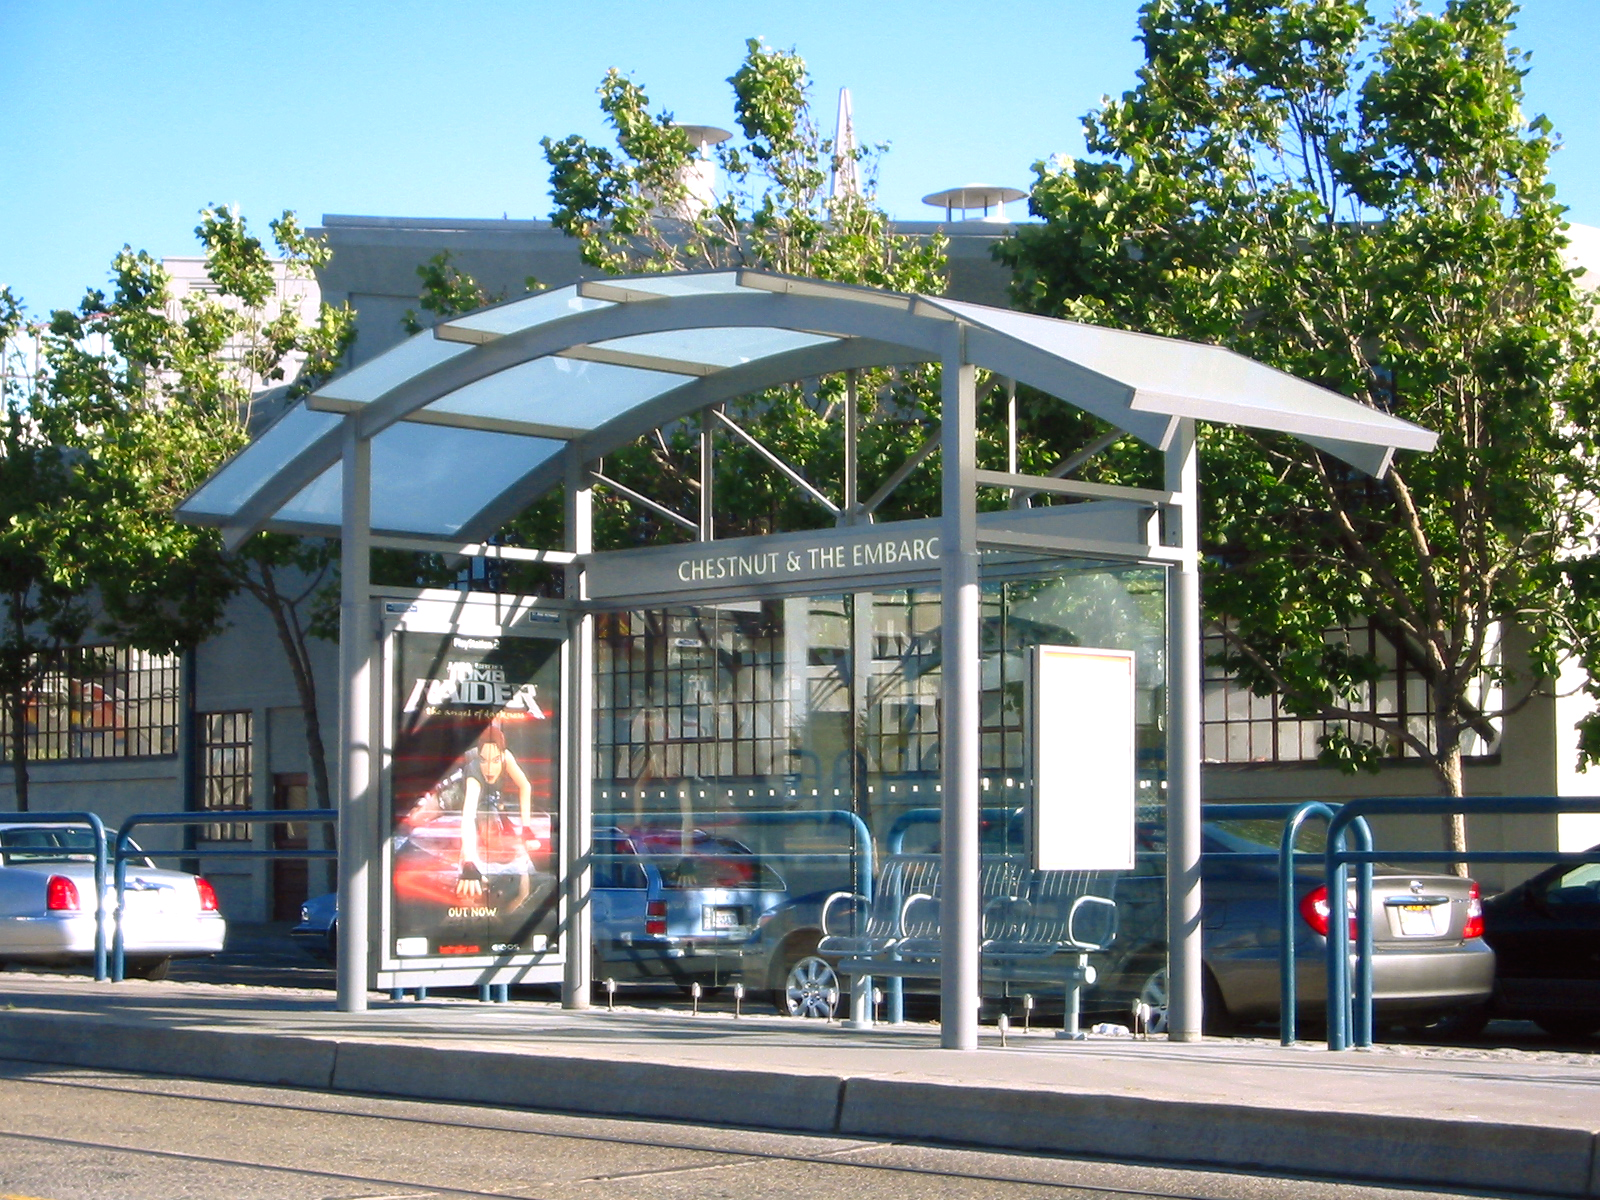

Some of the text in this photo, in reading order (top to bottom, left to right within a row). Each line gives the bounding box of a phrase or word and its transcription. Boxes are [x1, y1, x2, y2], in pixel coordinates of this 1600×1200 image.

[678, 537, 940, 582] CHESTNUT & THE EMBARC
[448, 906, 498, 918] OUT NOW
